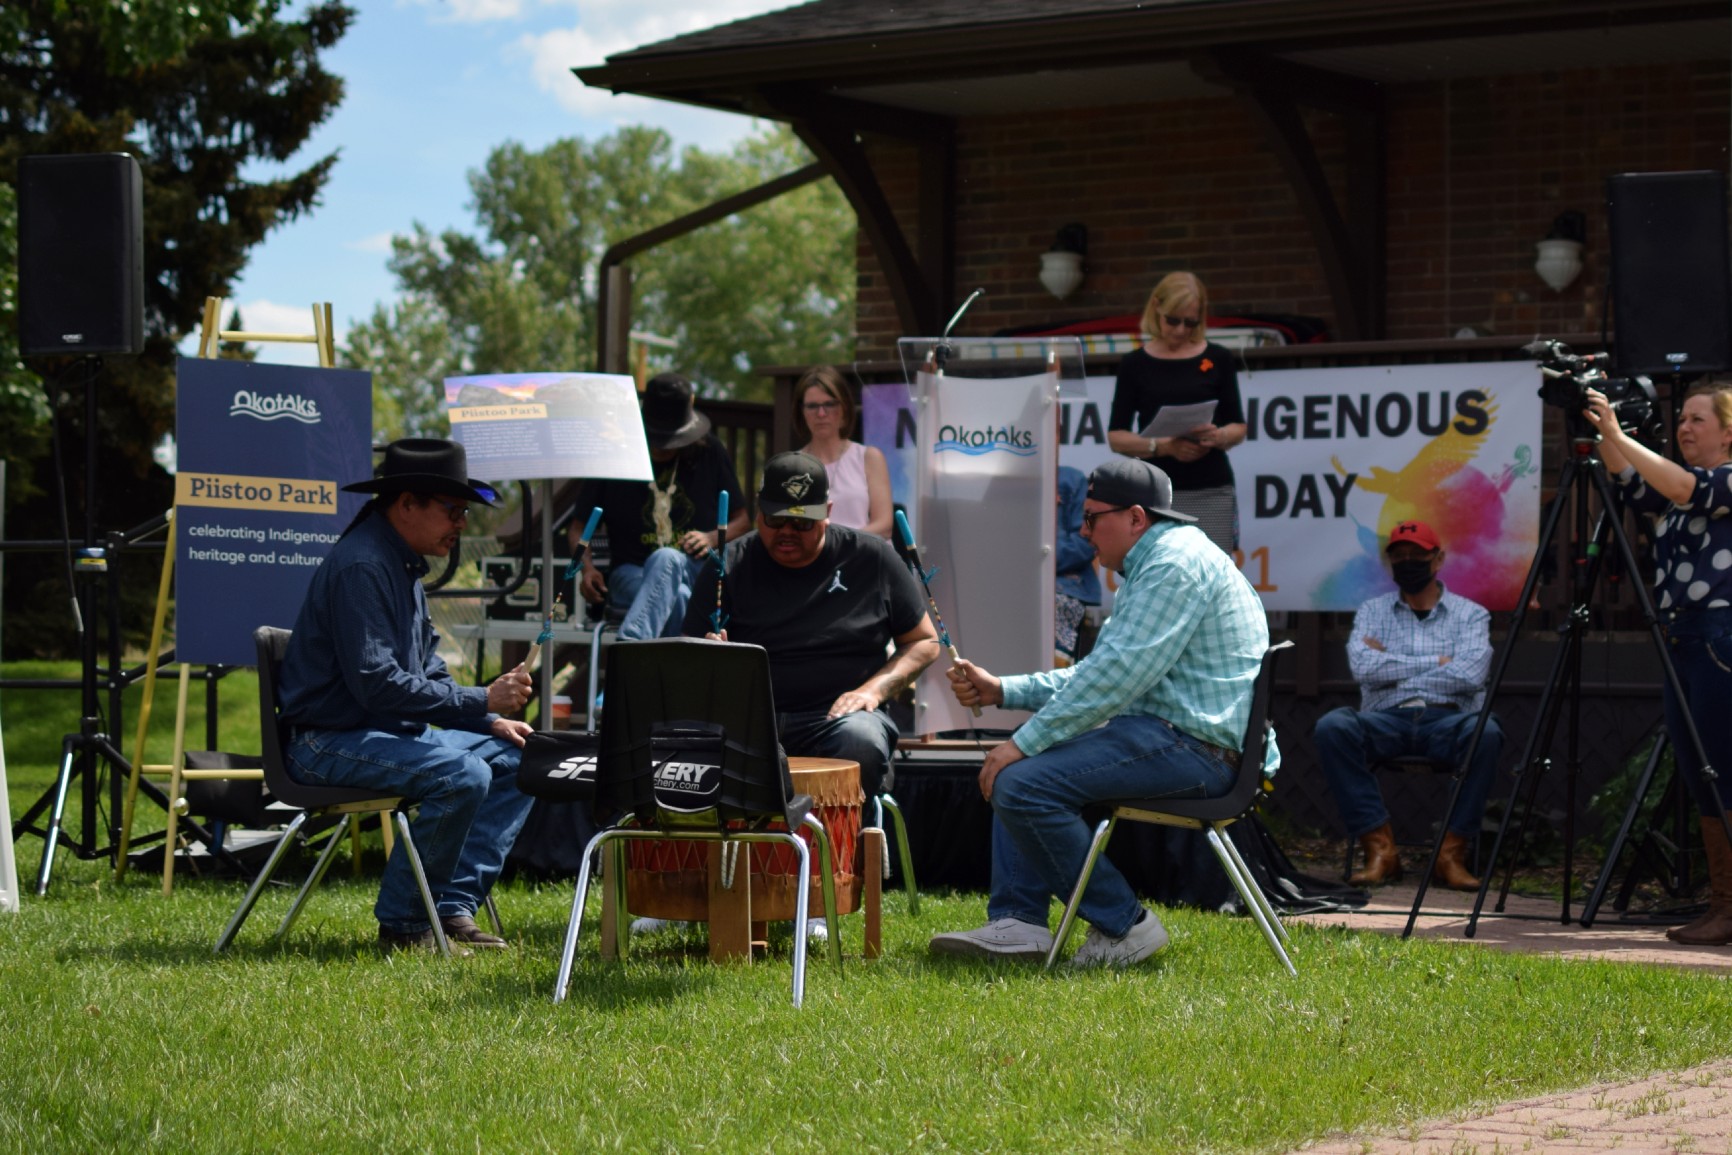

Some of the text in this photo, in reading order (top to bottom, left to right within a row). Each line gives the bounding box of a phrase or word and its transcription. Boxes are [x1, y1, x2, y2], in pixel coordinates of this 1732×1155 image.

[234, 390, 317, 416] Okotoks
[510, 406, 542, 416] Park
[1246, 389, 1489, 441] IGENOUS
[938, 425, 1033, 447] Okotoks
[190, 478, 334, 505] Piistoo Park
[1254, 473, 1358, 519] DAY
[188, 524, 266, 543] celebrating
[188, 547, 246, 565] heritage
[249, 552, 275, 564] and
